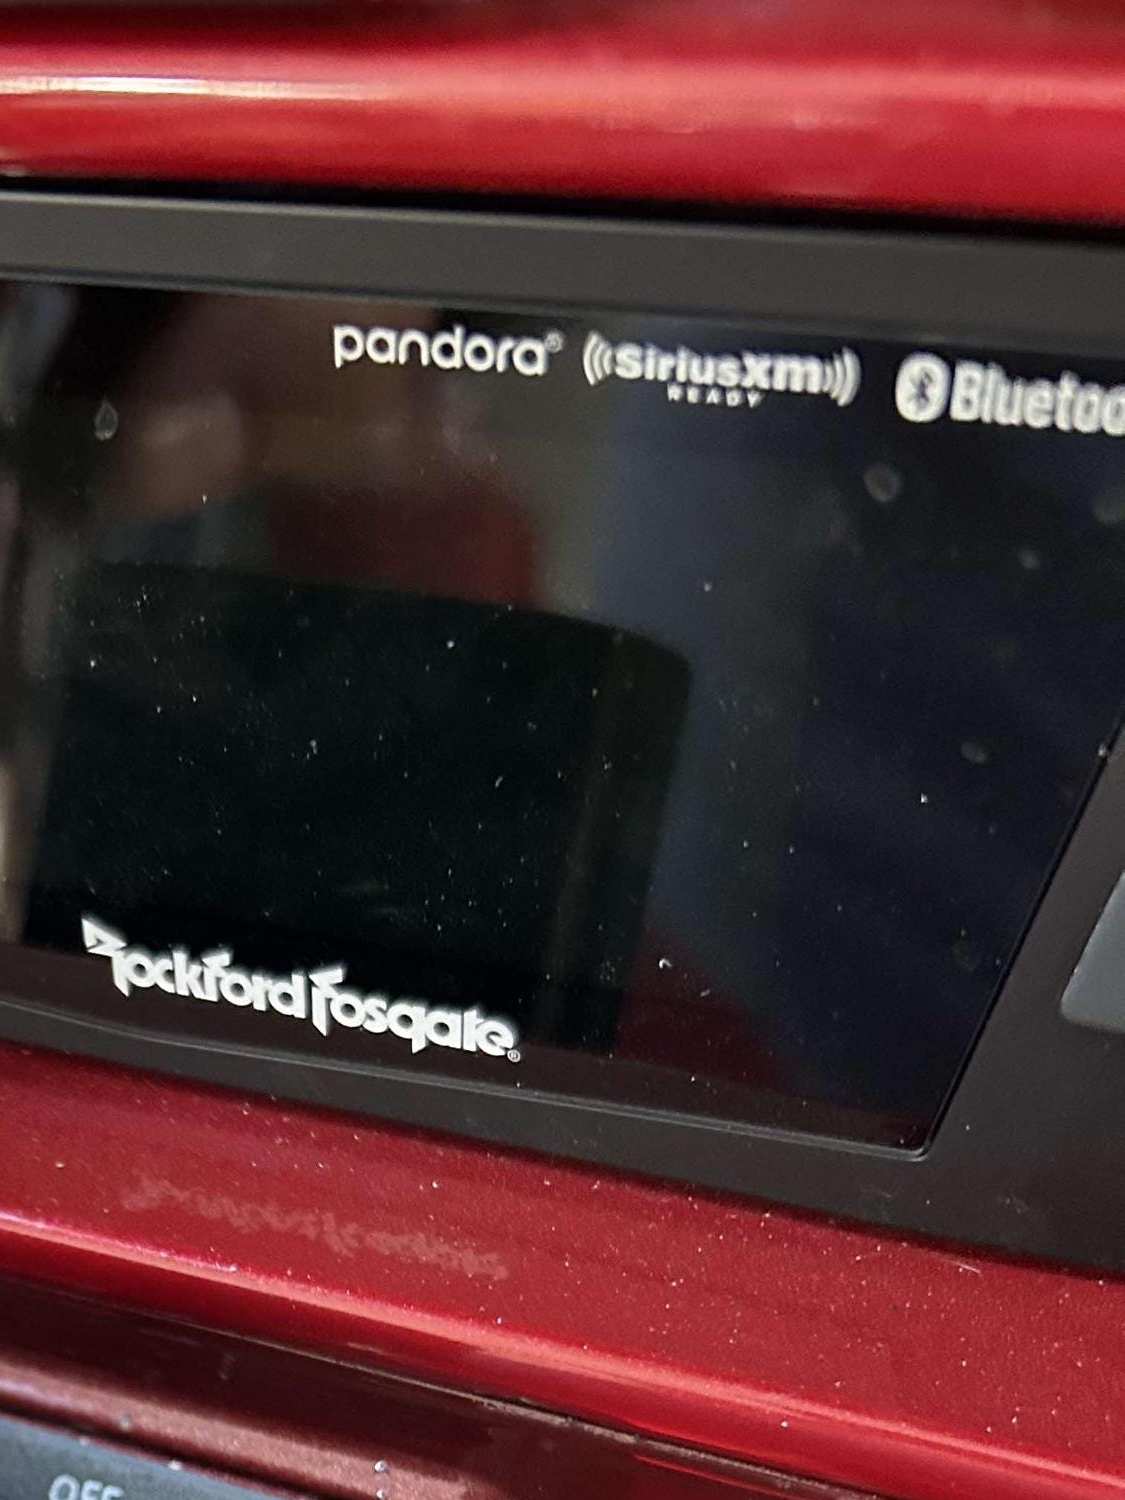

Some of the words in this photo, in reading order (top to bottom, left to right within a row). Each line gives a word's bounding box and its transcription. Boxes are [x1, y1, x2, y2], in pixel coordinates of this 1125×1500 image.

[333, 325, 548, 376] pandora
[667, 383, 763, 407] READY
[81, 916, 309, 1021] Rockford
[308, 967, 516, 1057] Fosgate
